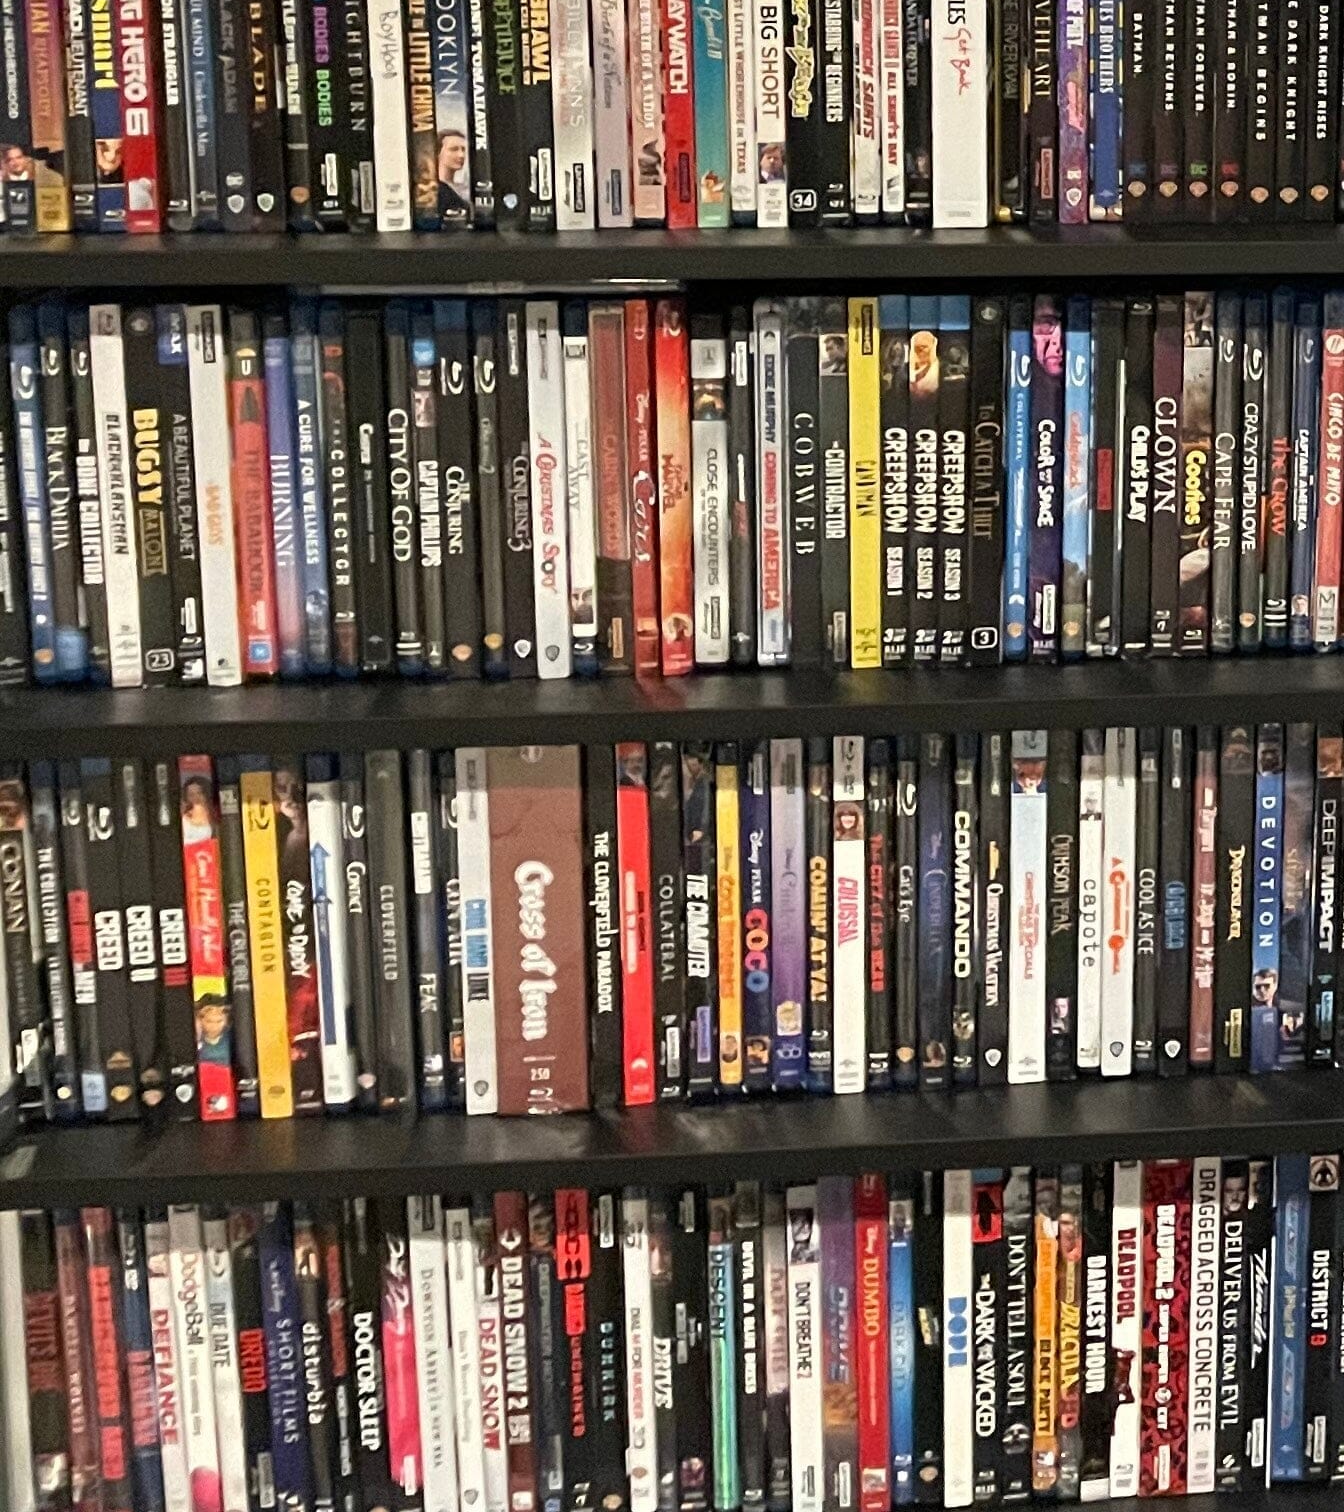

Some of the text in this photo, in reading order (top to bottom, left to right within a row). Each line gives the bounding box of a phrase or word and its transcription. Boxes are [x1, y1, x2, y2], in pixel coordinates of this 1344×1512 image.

[122, 27, 146, 102] HERO
[760, 5, 778, 40] BIG
[126, 107, 150, 137] 6
[761, 45, 780, 118] SHORT
[134, 408, 160, 504] BUGSY
[387, 408, 412, 561] CITY OF GOD
[793, 412, 814, 555] COBWEB
[1153, 398, 1177, 513] CLOWN
[1213, 432, 1236, 550] CAPE FEAR
[954, 810, 971, 978] COMMANDO
[1257, 795, 1276, 949] DEVOTION
[96, 910, 122, 970] CREED
[745, 908, 770, 992] COCO
[1080, 879, 1099, 967] capote
[864, 1258, 882, 1336] DUMBO
[1084, 1256, 1105, 1393] DARKEST HOUR
[1194, 1168, 1218, 1433] DRAGGED ACROSS CONCRETE
[1310, 1249, 1329, 1346] DISTRICT 9
[301, 1324, 326, 1424] disturbia
